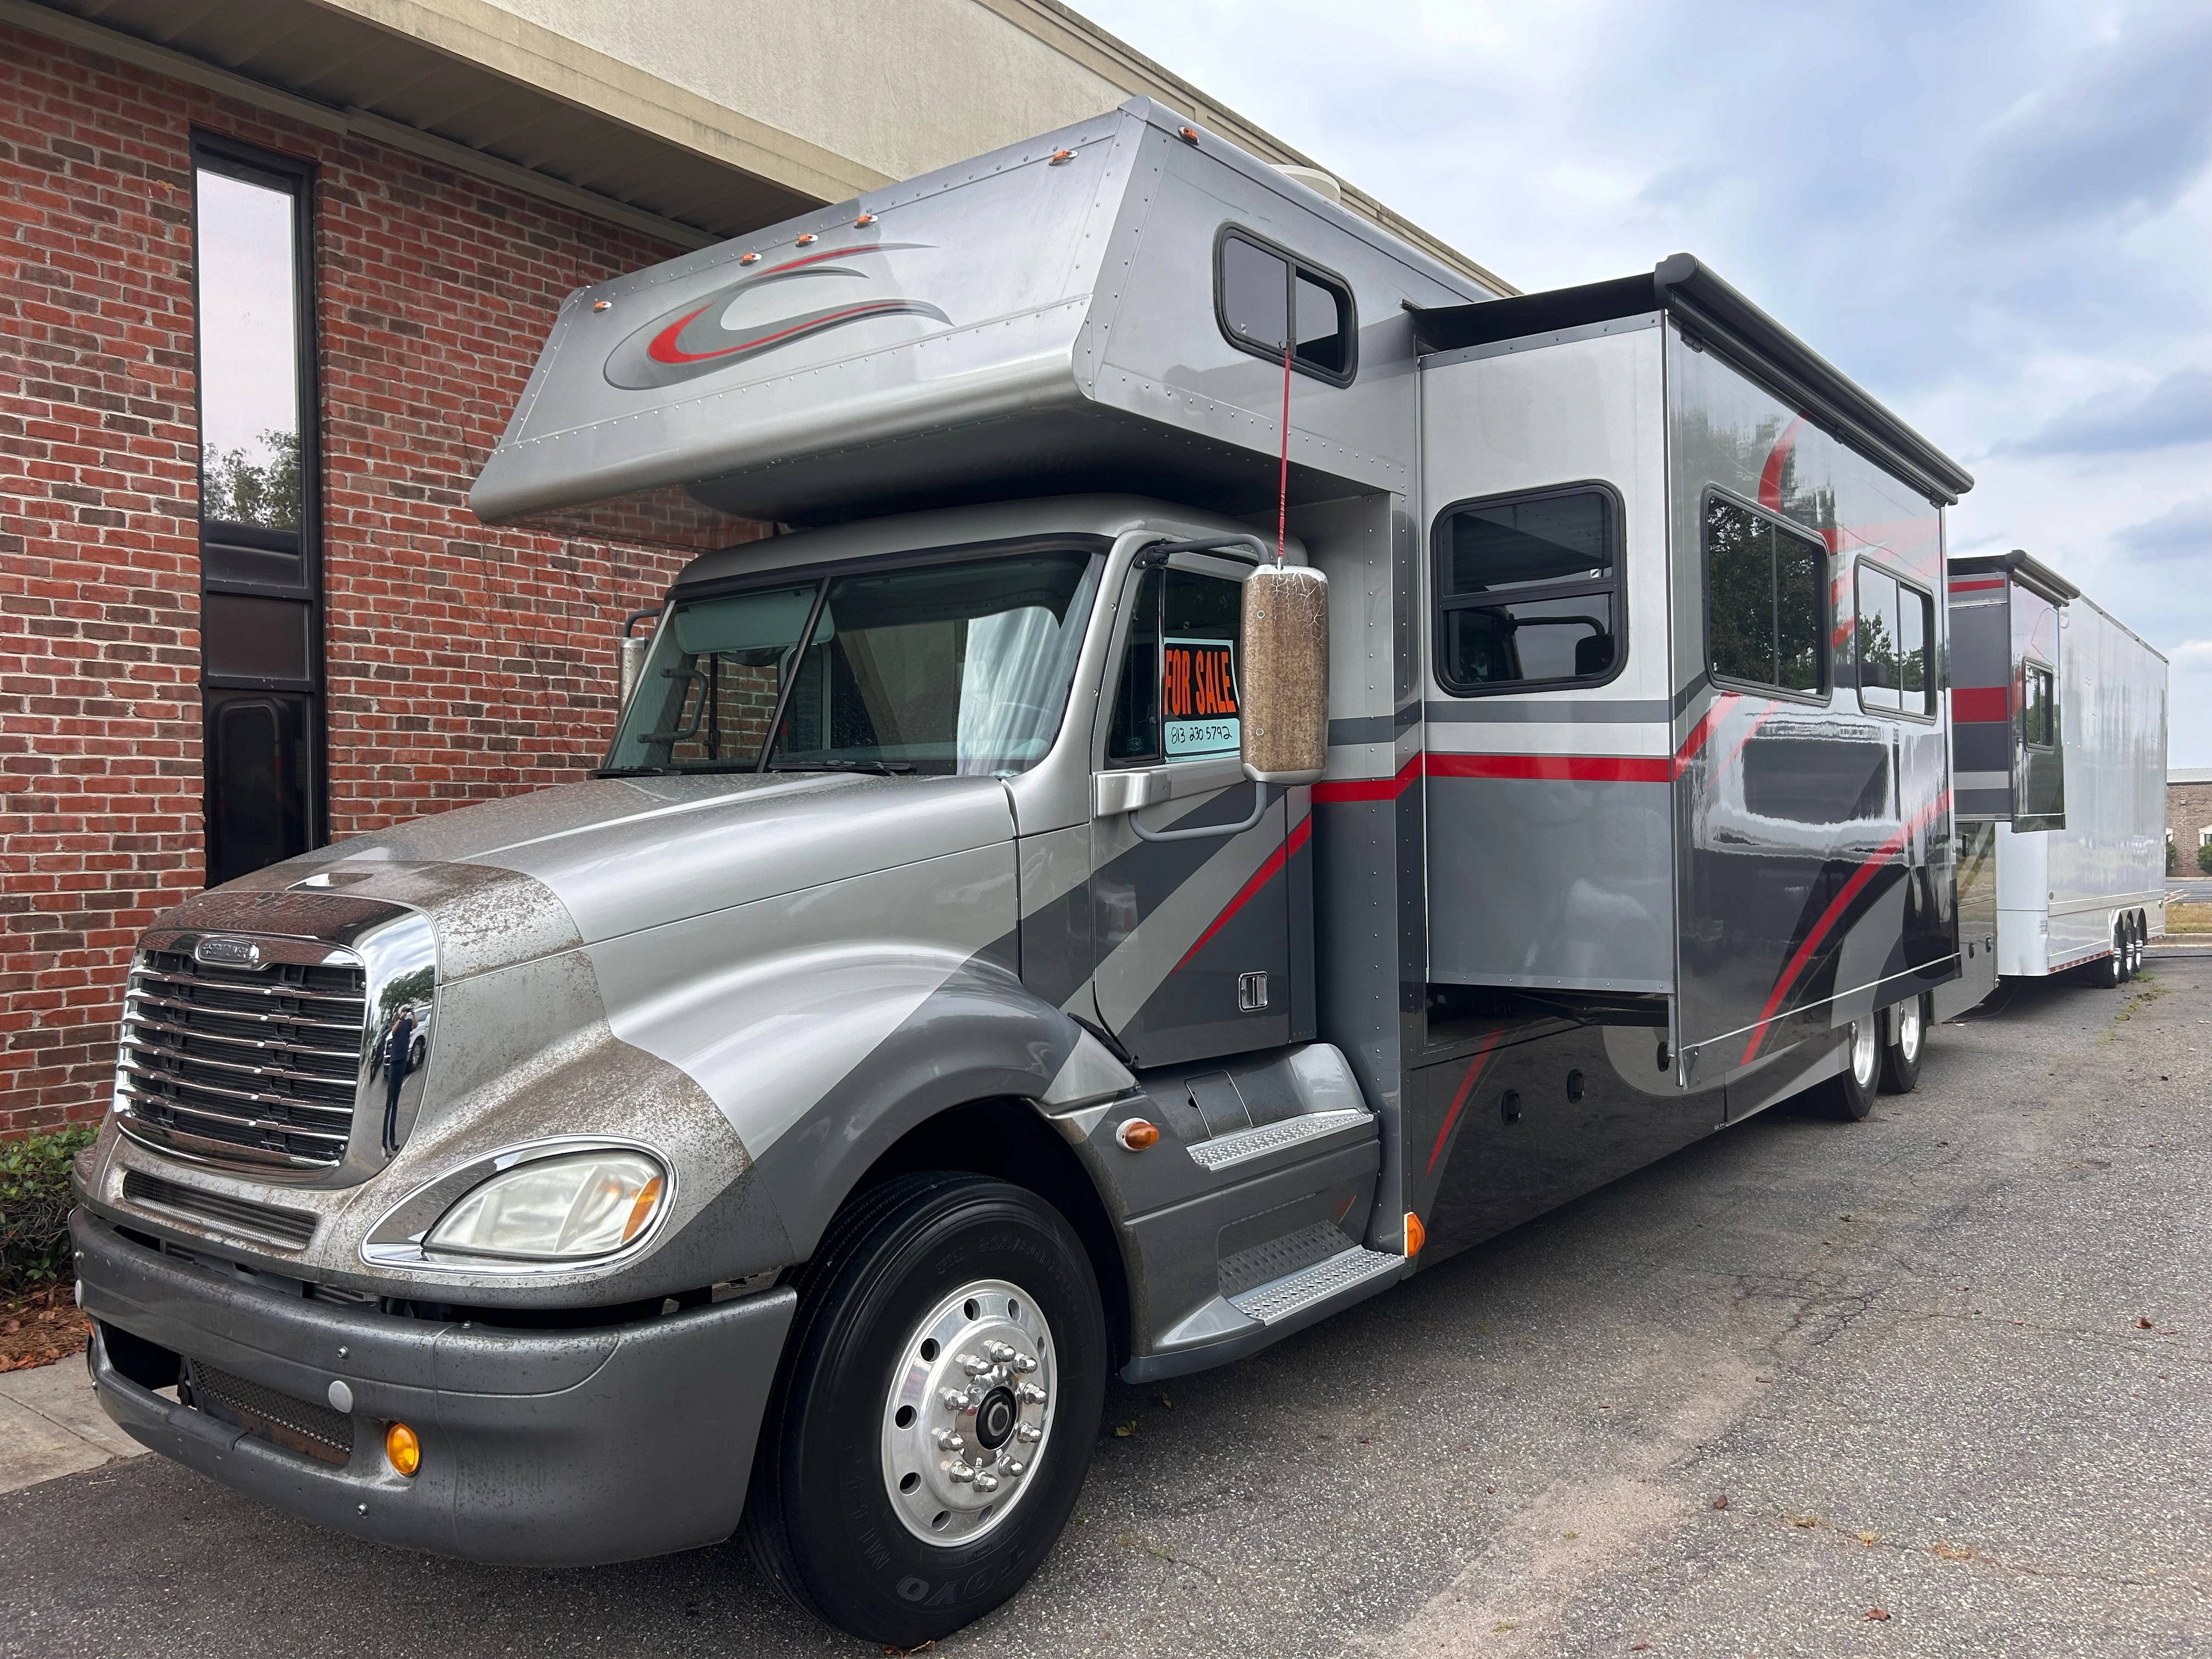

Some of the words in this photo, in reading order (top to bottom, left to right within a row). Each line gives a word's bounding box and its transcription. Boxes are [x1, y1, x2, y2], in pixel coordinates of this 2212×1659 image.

[1164, 649, 1191, 716] FOR
[1195, 650, 1236, 715] SALE
[1171, 726, 1186, 744] 813
[1189, 726, 1204, 742] 230
[1206, 726, 1232, 740] 5792
[895, 1544, 1026, 1606] TOYO
